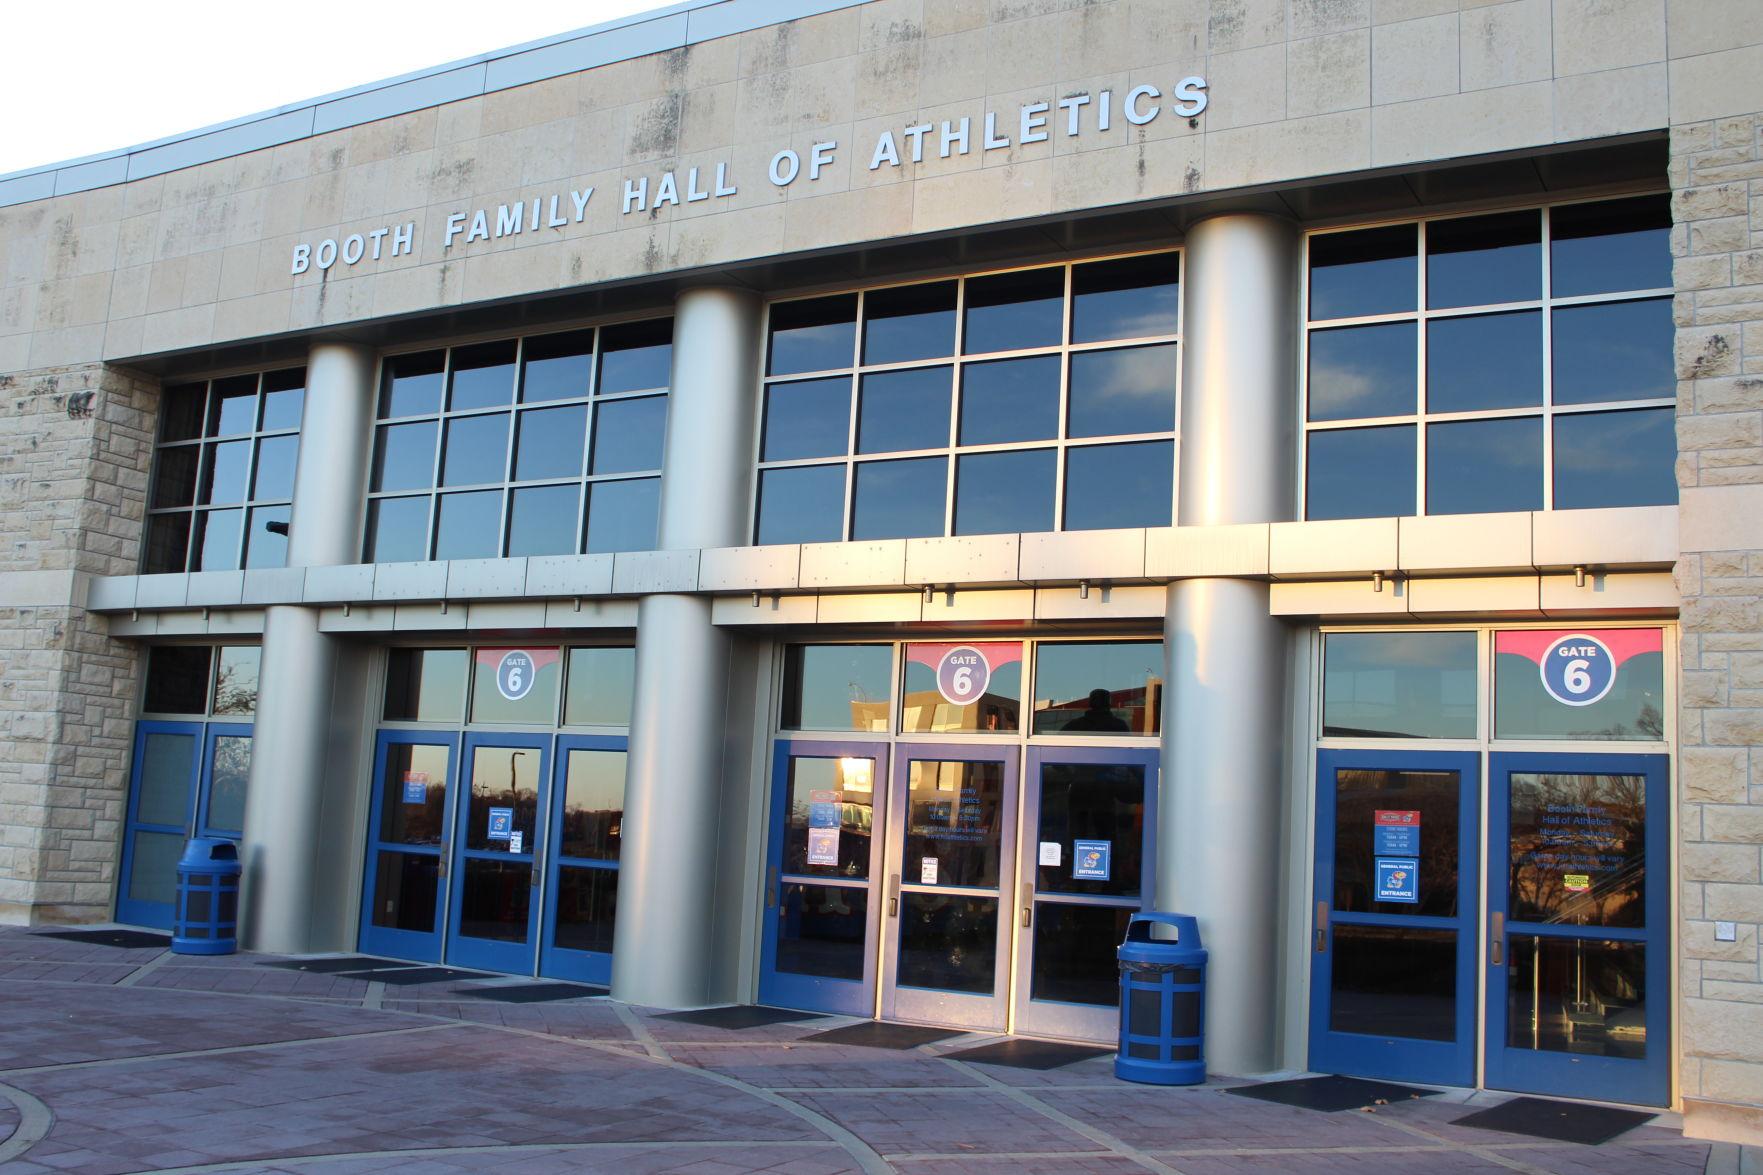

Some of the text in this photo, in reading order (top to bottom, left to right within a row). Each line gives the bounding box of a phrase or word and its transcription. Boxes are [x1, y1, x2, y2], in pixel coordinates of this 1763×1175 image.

[291, 76, 1208, 275] BOOTH FAMILY HALL OF ATHLETICS
[1558, 646, 1596, 657] GATE
[507, 658, 526, 666] GATE
[950, 656, 977, 665] GATE
[508, 667, 522, 692] 6
[953, 666, 972, 696] 6
[1563, 659, 1591, 694] 6
[1547, 803, 1574, 813] Booth
[1542, 815, 1612, 826] Hall of Athletics
